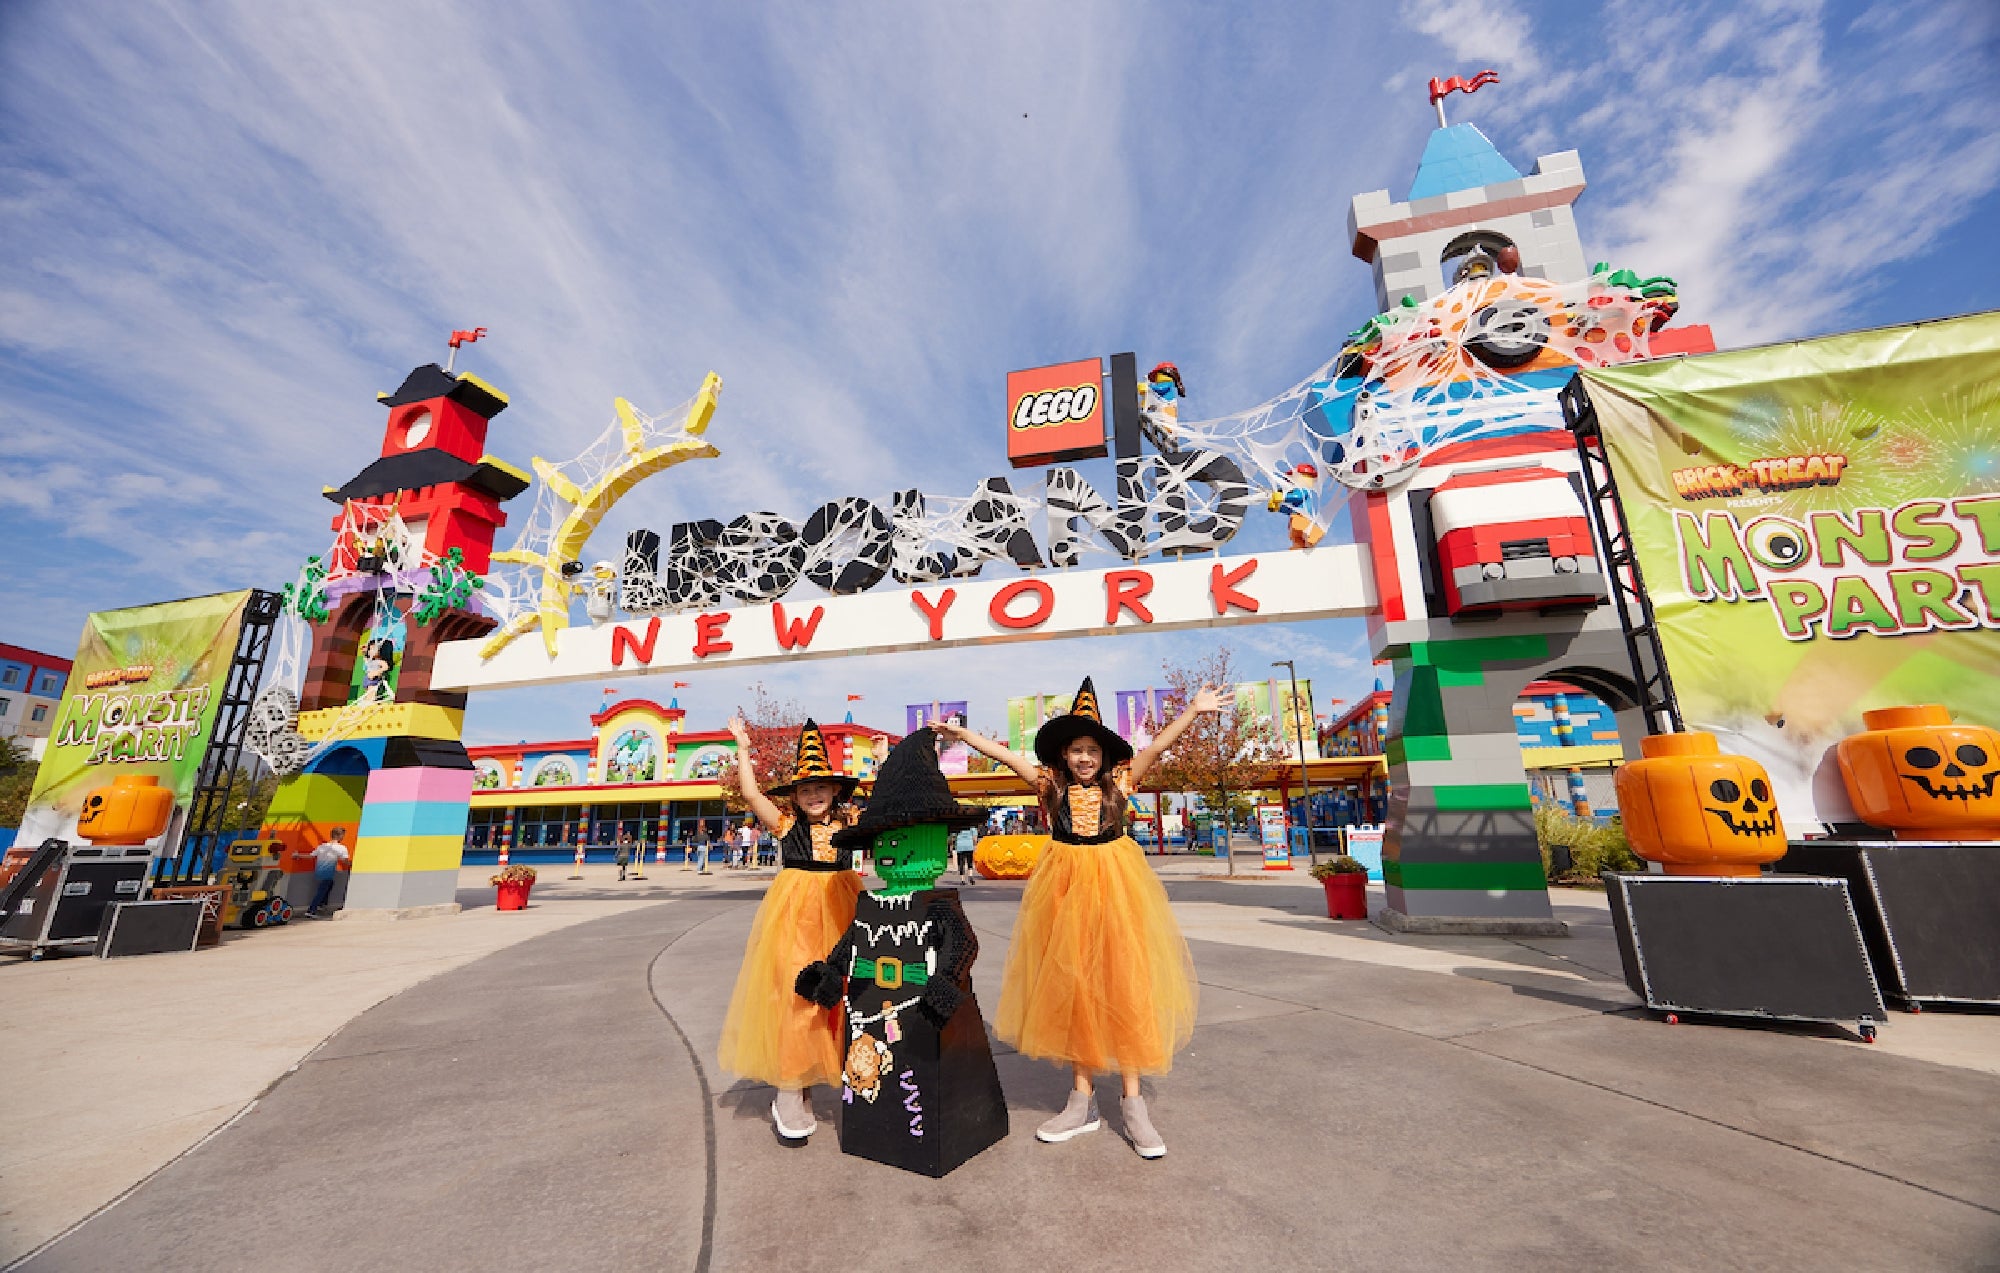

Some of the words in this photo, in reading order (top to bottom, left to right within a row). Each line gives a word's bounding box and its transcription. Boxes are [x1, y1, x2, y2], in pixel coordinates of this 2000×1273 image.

[1013, 385, 1097, 429] LEGO
[1672, 465, 1740, 498] BRICK
[1750, 454, 1848, 490] TREAT
[1726, 495, 1783, 508] PRESENTS
[611, 601, 825, 666] NEW
[911, 558, 1259, 640] YORK
[87, 725, 192, 763] PARTY
